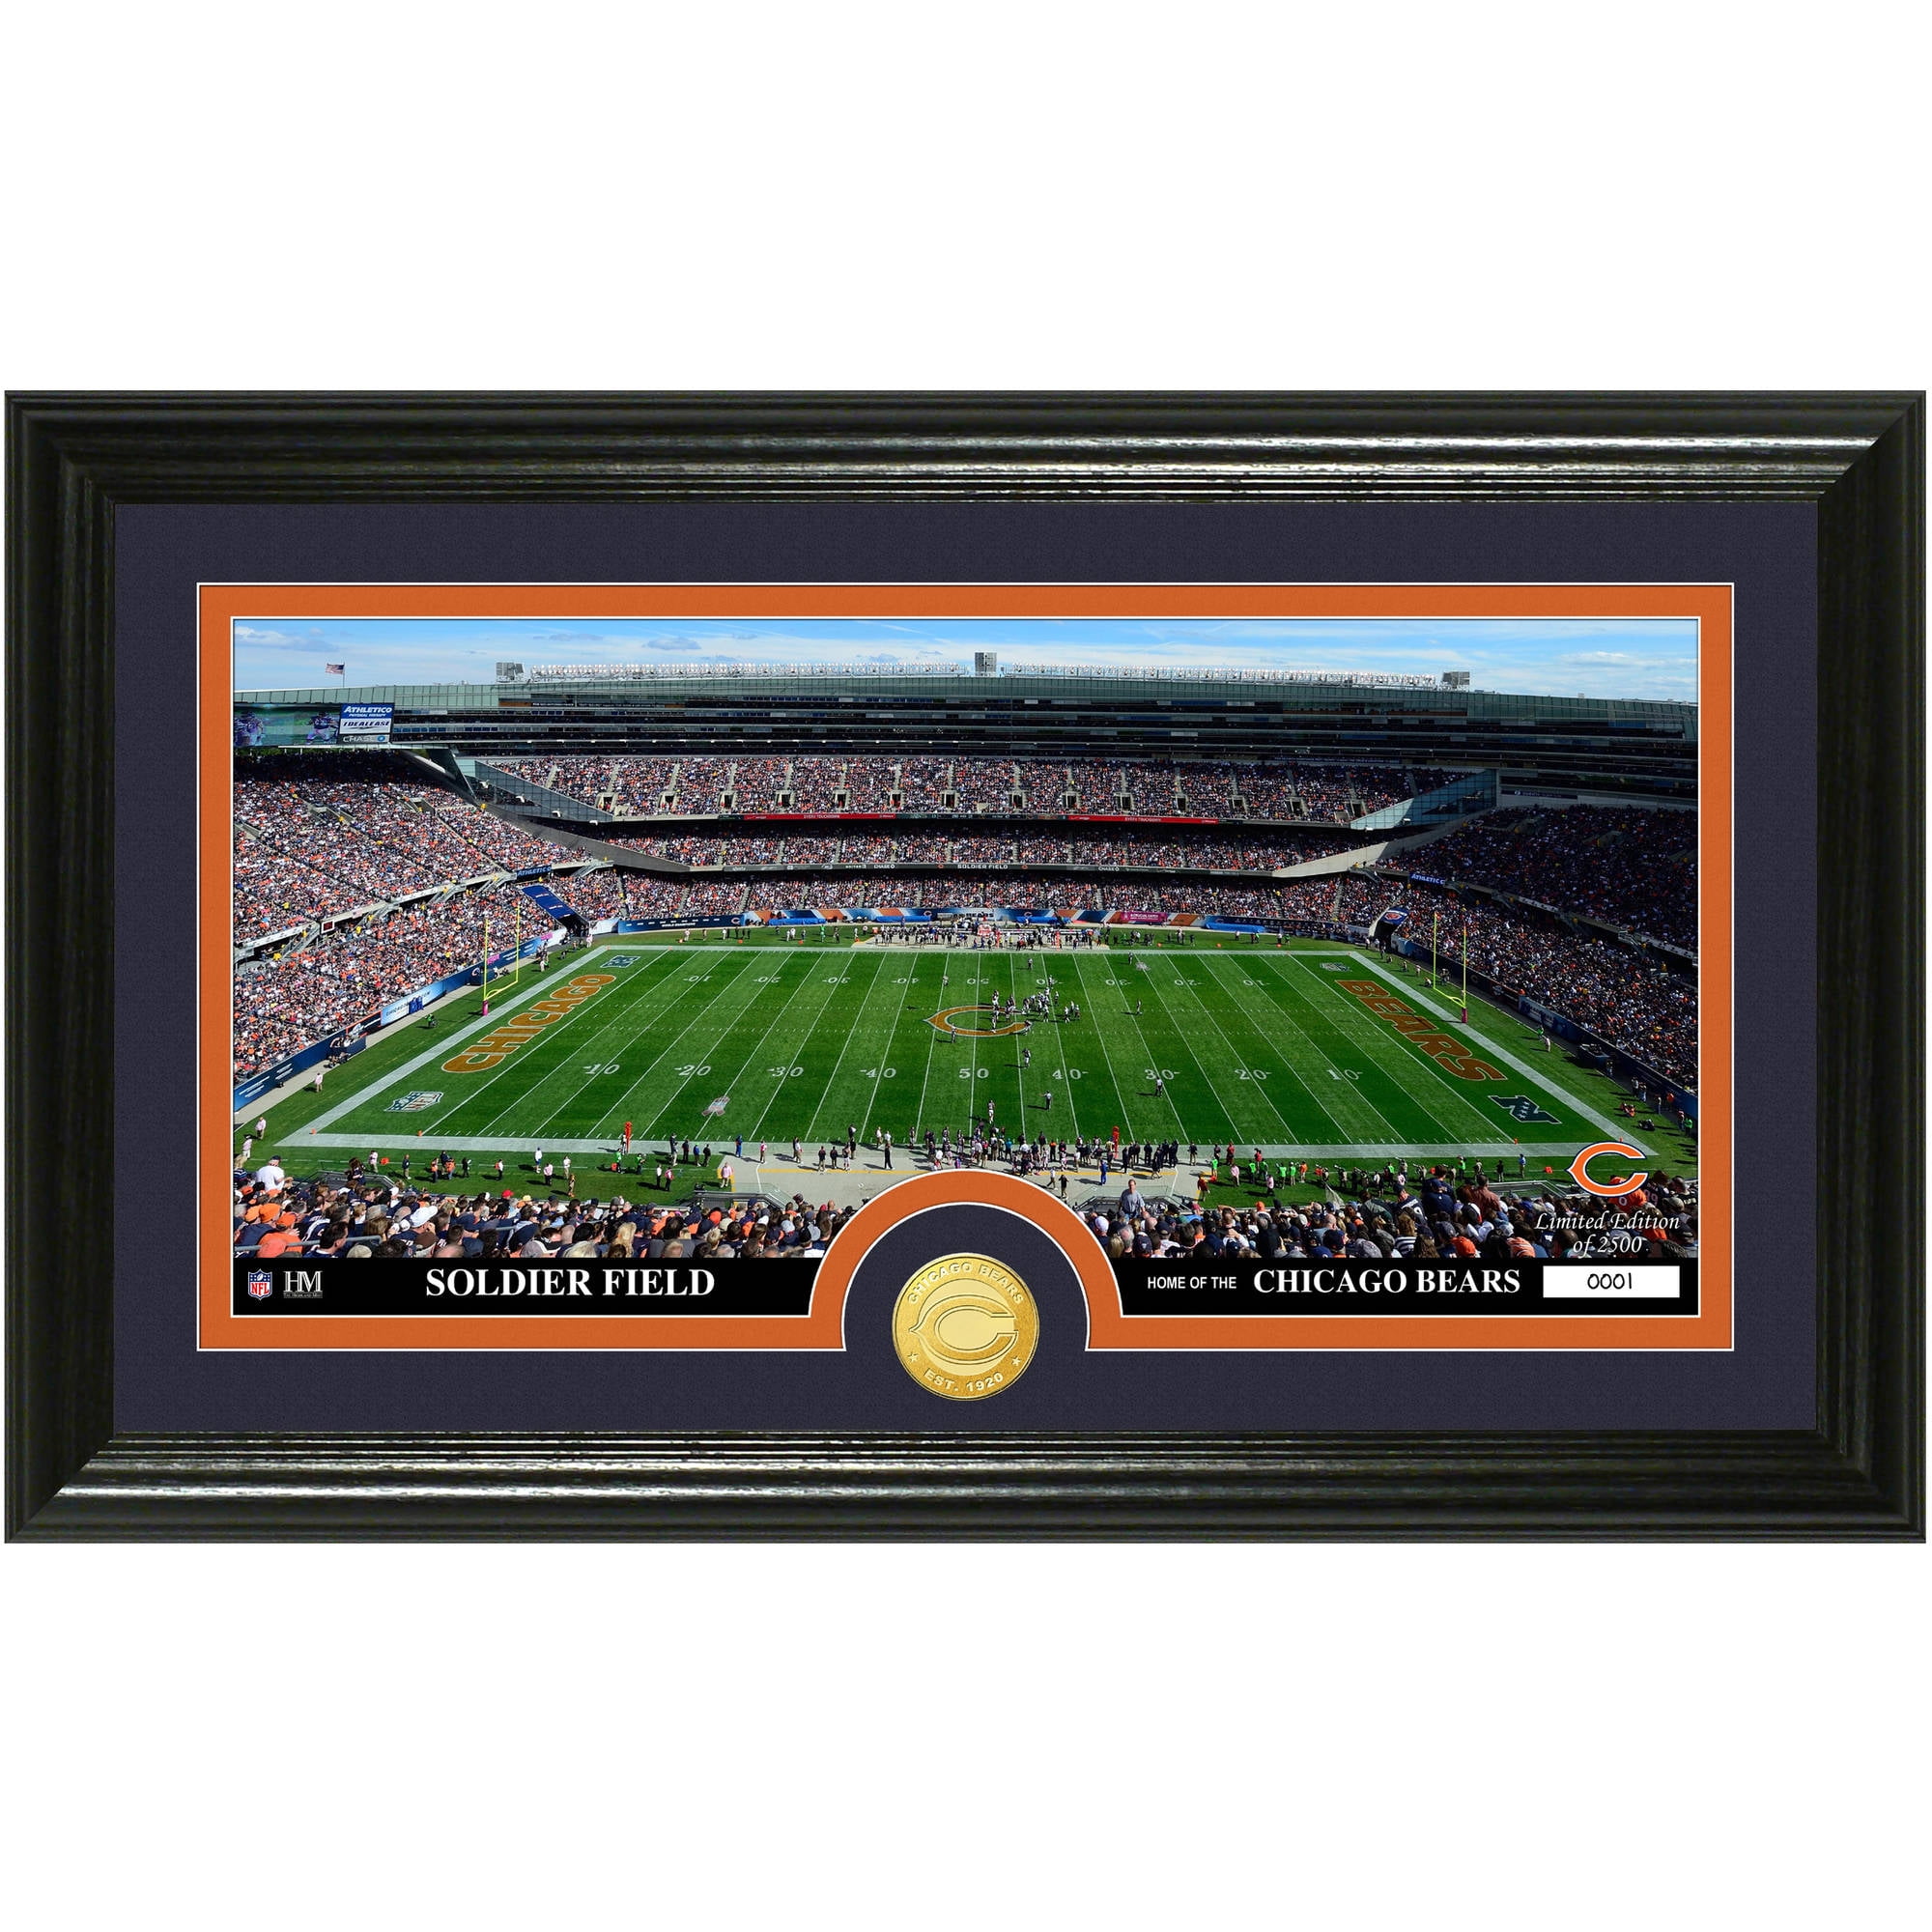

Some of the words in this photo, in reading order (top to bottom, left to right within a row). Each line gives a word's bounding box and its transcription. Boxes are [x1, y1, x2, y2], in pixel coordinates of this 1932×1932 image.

[441, 974, 616, 1073] CHICAGO
[1334, 979, 1509, 1081] BEARS
[590, 1064, 620, 1075] 10
[682, 1065, 712, 1076] 20
[773, 1066, 804, 1078] 30
[867, 1067, 896, 1079] 40
[958, 1068, 990, 1080] 50
[1052, 1068, 1082, 1080] 40
[1145, 1068, 1175, 1080] 30
[1235, 1069, 1267, 1080] 20
[1327, 1069, 1359, 1080] 10
[1534, 1211, 1604, 1230] Limited
[1610, 1210, 1680, 1230] Edition
[1573, 1236, 1598, 1259] of
[1599, 1236, 1643, 1254] 2500
[426, 1268, 593, 1296] SOLDIER
[602, 1268, 715, 1296] FIELD
[907, 1262, 974, 1304] CHICAGO
[978, 1264, 1024, 1304] BEARS
[1147, 1276, 1186, 1290] HOME
[1189, 1276, 1208, 1290] OF
[1210, 1276, 1237, 1290] THE
[1253, 1268, 1407, 1294] CHICAGO
[1415, 1268, 1521, 1294] BEARS
[1586, 1272, 1634, 1291] 0001
[251, 1282, 270, 1295] NFL
[923, 1368, 960, 1392] EST.
[966, 1371, 1004, 1392] 1920
